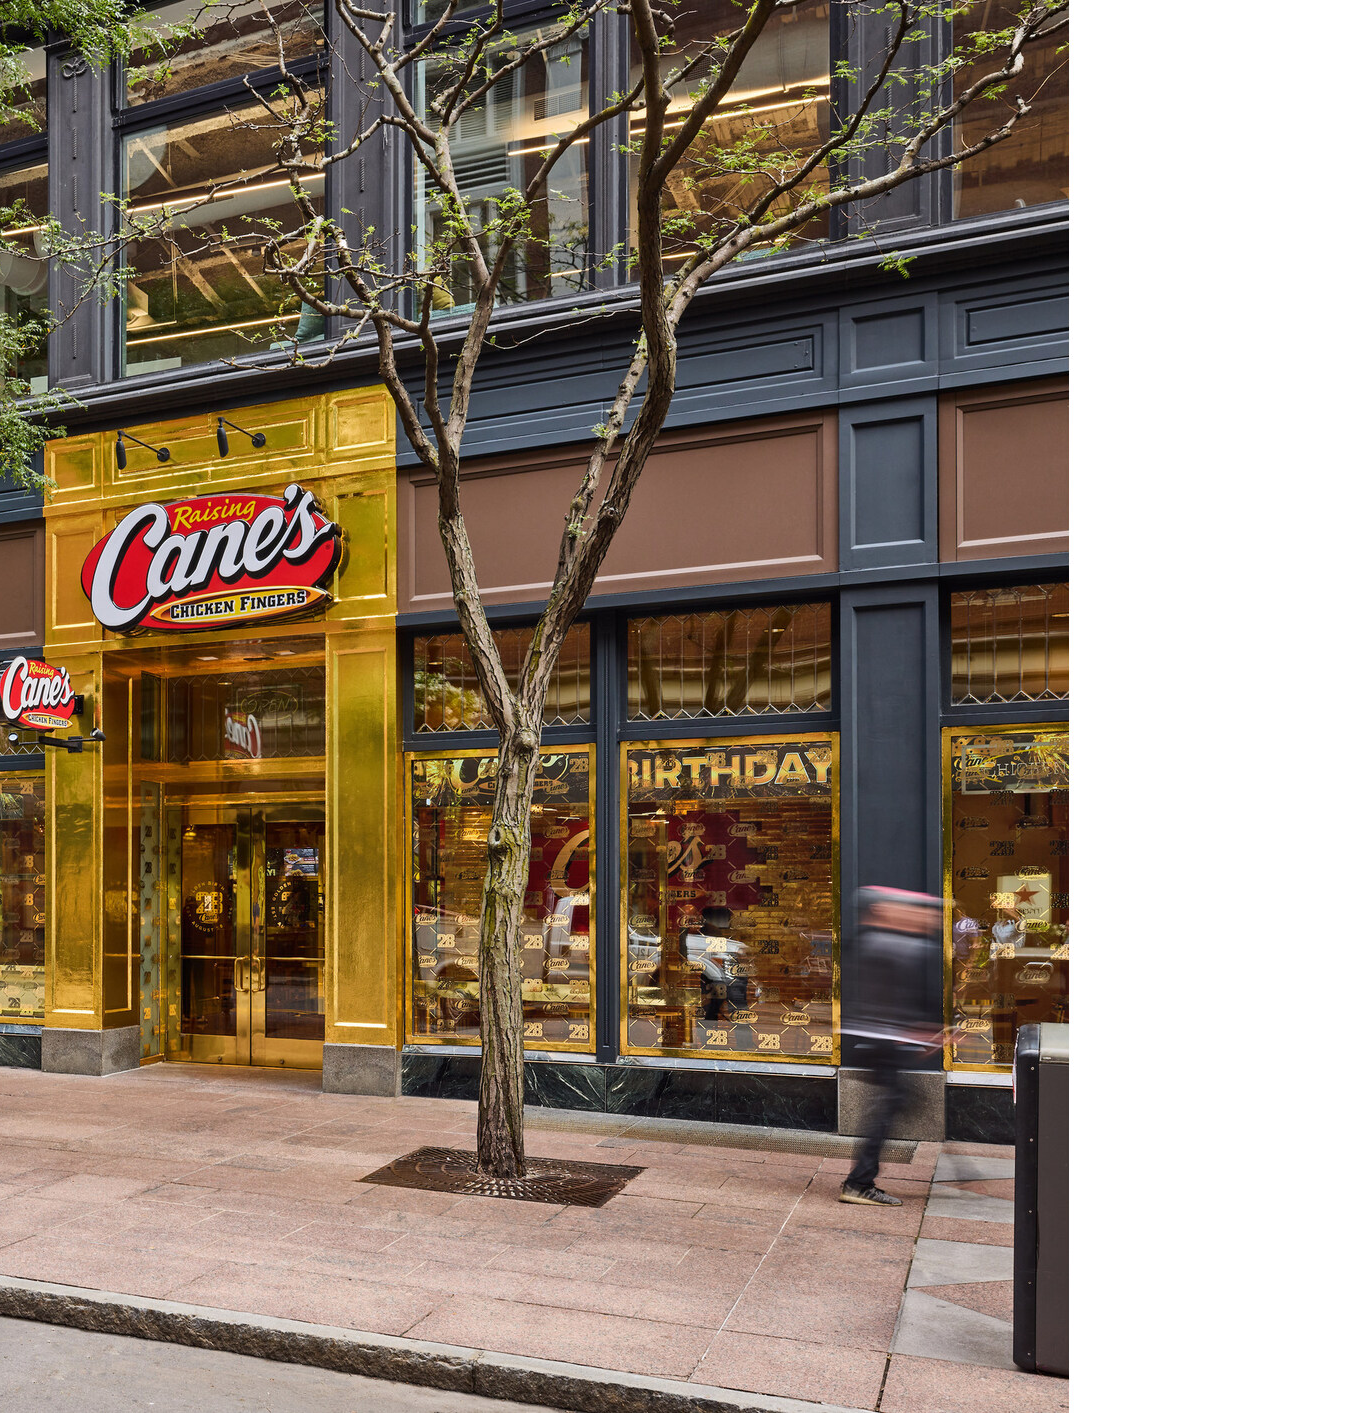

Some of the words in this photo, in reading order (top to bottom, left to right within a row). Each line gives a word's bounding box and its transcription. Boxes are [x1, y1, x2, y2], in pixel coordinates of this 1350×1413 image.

[173, 499, 256, 531] Raising
[91, 484, 336, 629] Cane's
[170, 600, 235, 619] CHICKEN
[240, 591, 307, 611] FINGERS
[29, 662, 54, 680] Raising
[2, 656, 75, 720] Cane's
[28, 713, 48, 724] CHICKEN
[48, 716, 68, 727] FINGERS
[570, 758, 589, 772] 28
[628, 751, 832, 789] BIRTHDAY
[20, 782, 33, 794] 28
[196, 891, 223, 914] 28
[990, 893, 1014, 908] 28
[20, 930, 33, 942] 28
[437, 934, 456, 948] 28
[524, 935, 543, 949] 28
[569, 935, 589, 950] 28
[706, 937, 727, 952] 28
[990, 943, 1015, 959] 28
[9, 998, 20, 1008] 28
[524, 1022, 543, 1037] 28
[569, 1024, 589, 1039] 28
[706, 1030, 727, 1045] 28
[759, 1034, 780, 1049] 28
[811, 1036, 832, 1051] 28
